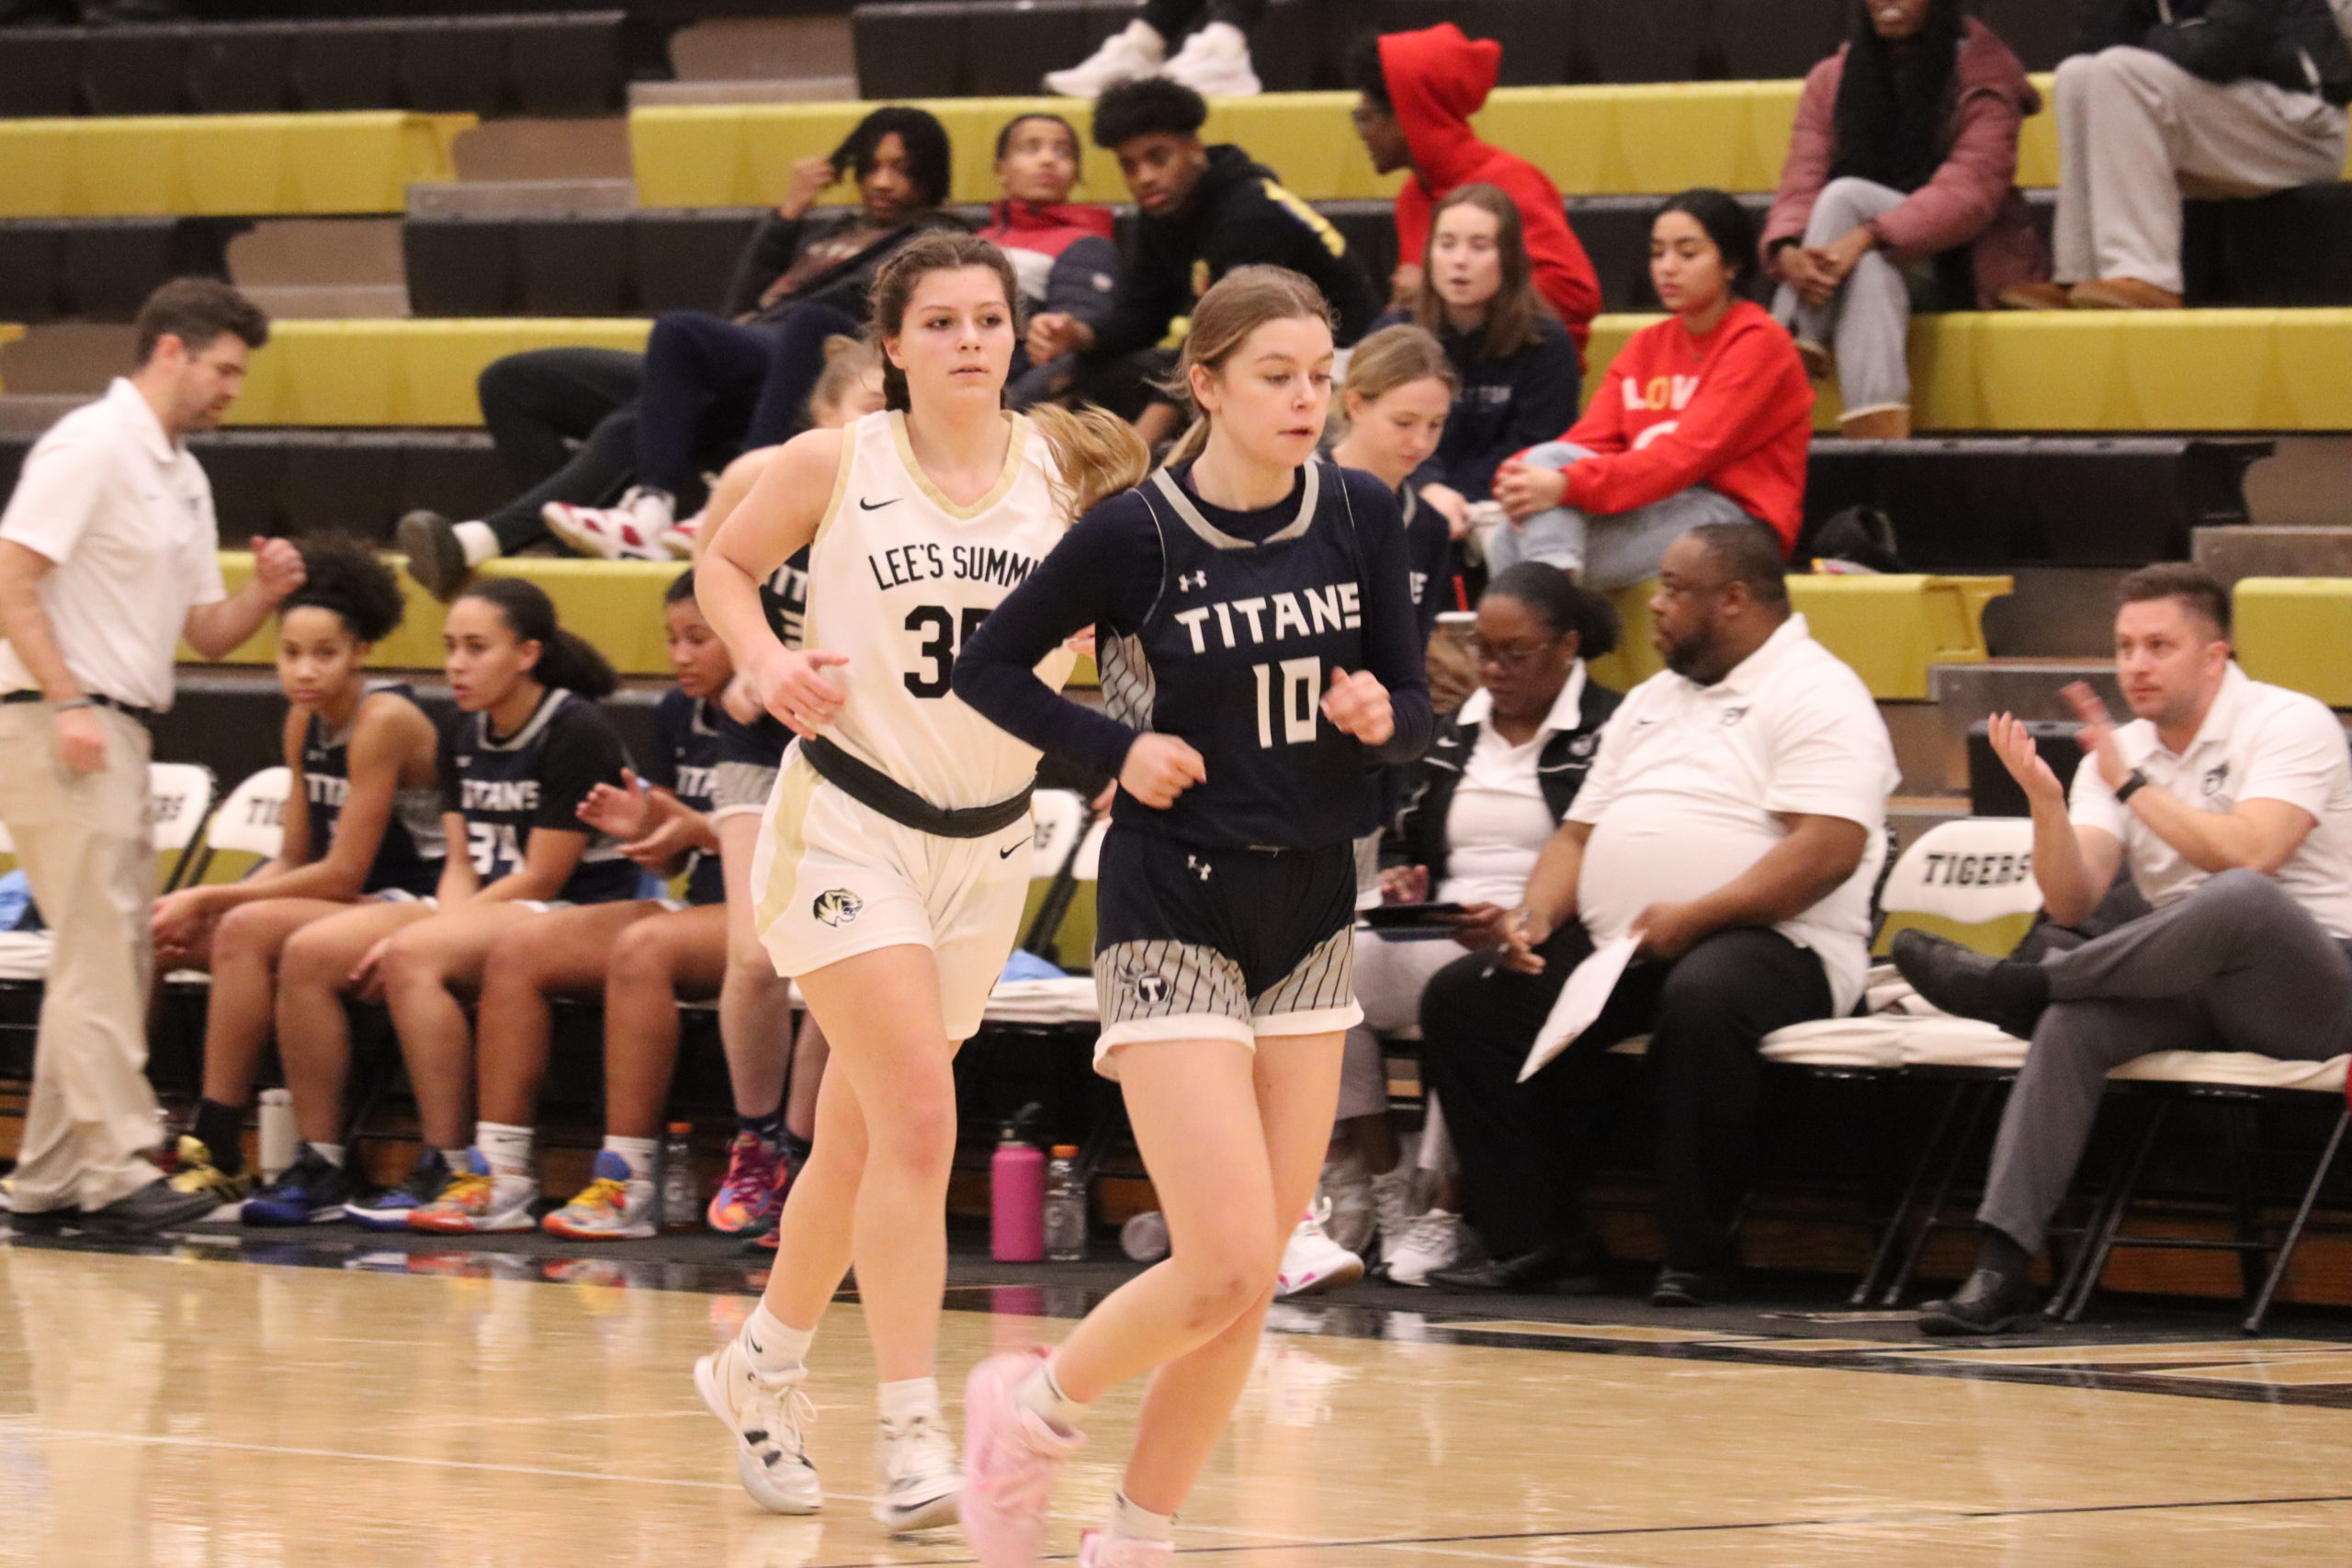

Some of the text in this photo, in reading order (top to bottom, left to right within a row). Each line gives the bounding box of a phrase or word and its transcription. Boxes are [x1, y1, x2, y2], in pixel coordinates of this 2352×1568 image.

[1621, 374, 1700, 411] LOV
[868, 543, 944, 591] LEE'S
[1173, 581, 1362, 654] TITANS
[1251, 655, 1322, 750] 10
[1922, 852, 2032, 886] TIGERS
